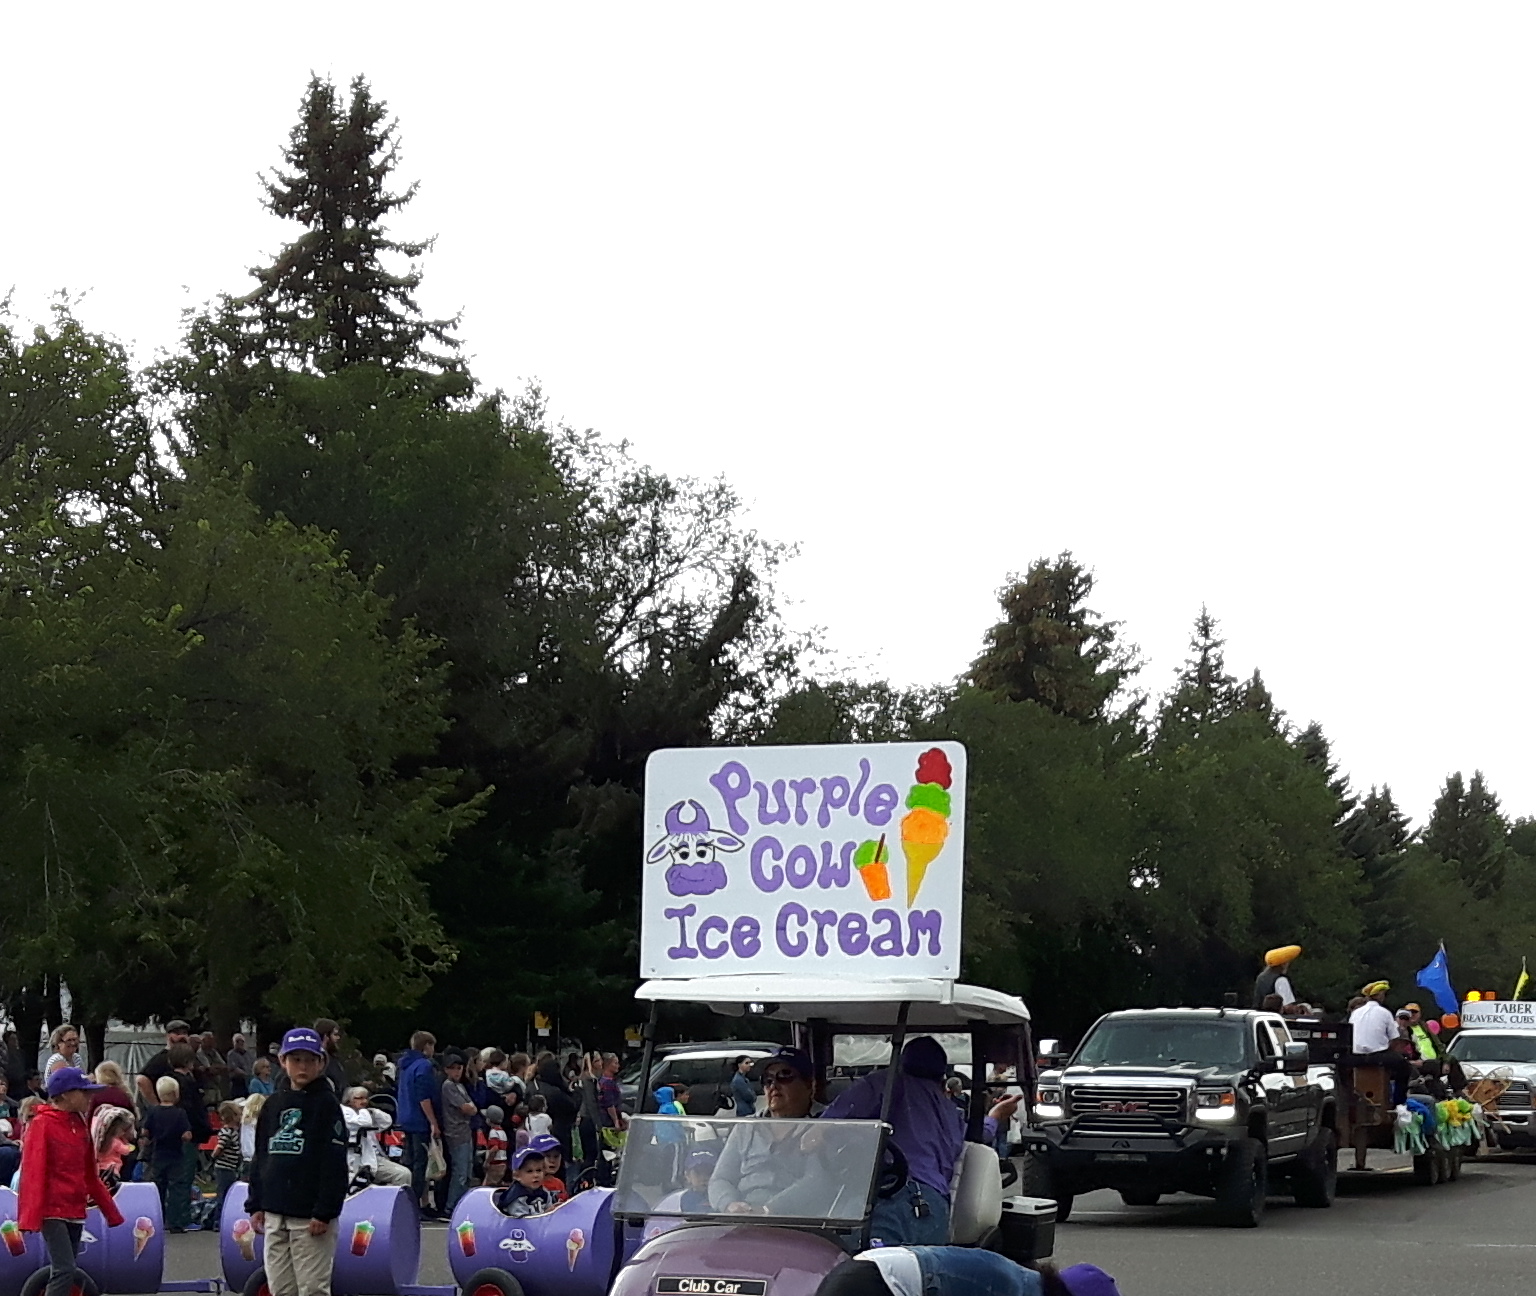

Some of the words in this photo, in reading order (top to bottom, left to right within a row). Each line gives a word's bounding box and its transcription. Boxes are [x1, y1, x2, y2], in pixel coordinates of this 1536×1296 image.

[709, 757, 899, 836] Purple
[664, 903, 762, 960] Ice
[775, 901, 943, 958] Cream
[1493, 1003, 1532, 1014] TABER
[1463, 1014, 1507, 1024] BEAVERS,
[1509, 1015, 1535, 1024] CUBS
[1100, 1100, 1150, 1113] GMC
[678, 1279, 710, 1293] Club
[713, 1280, 741, 1294] Car
